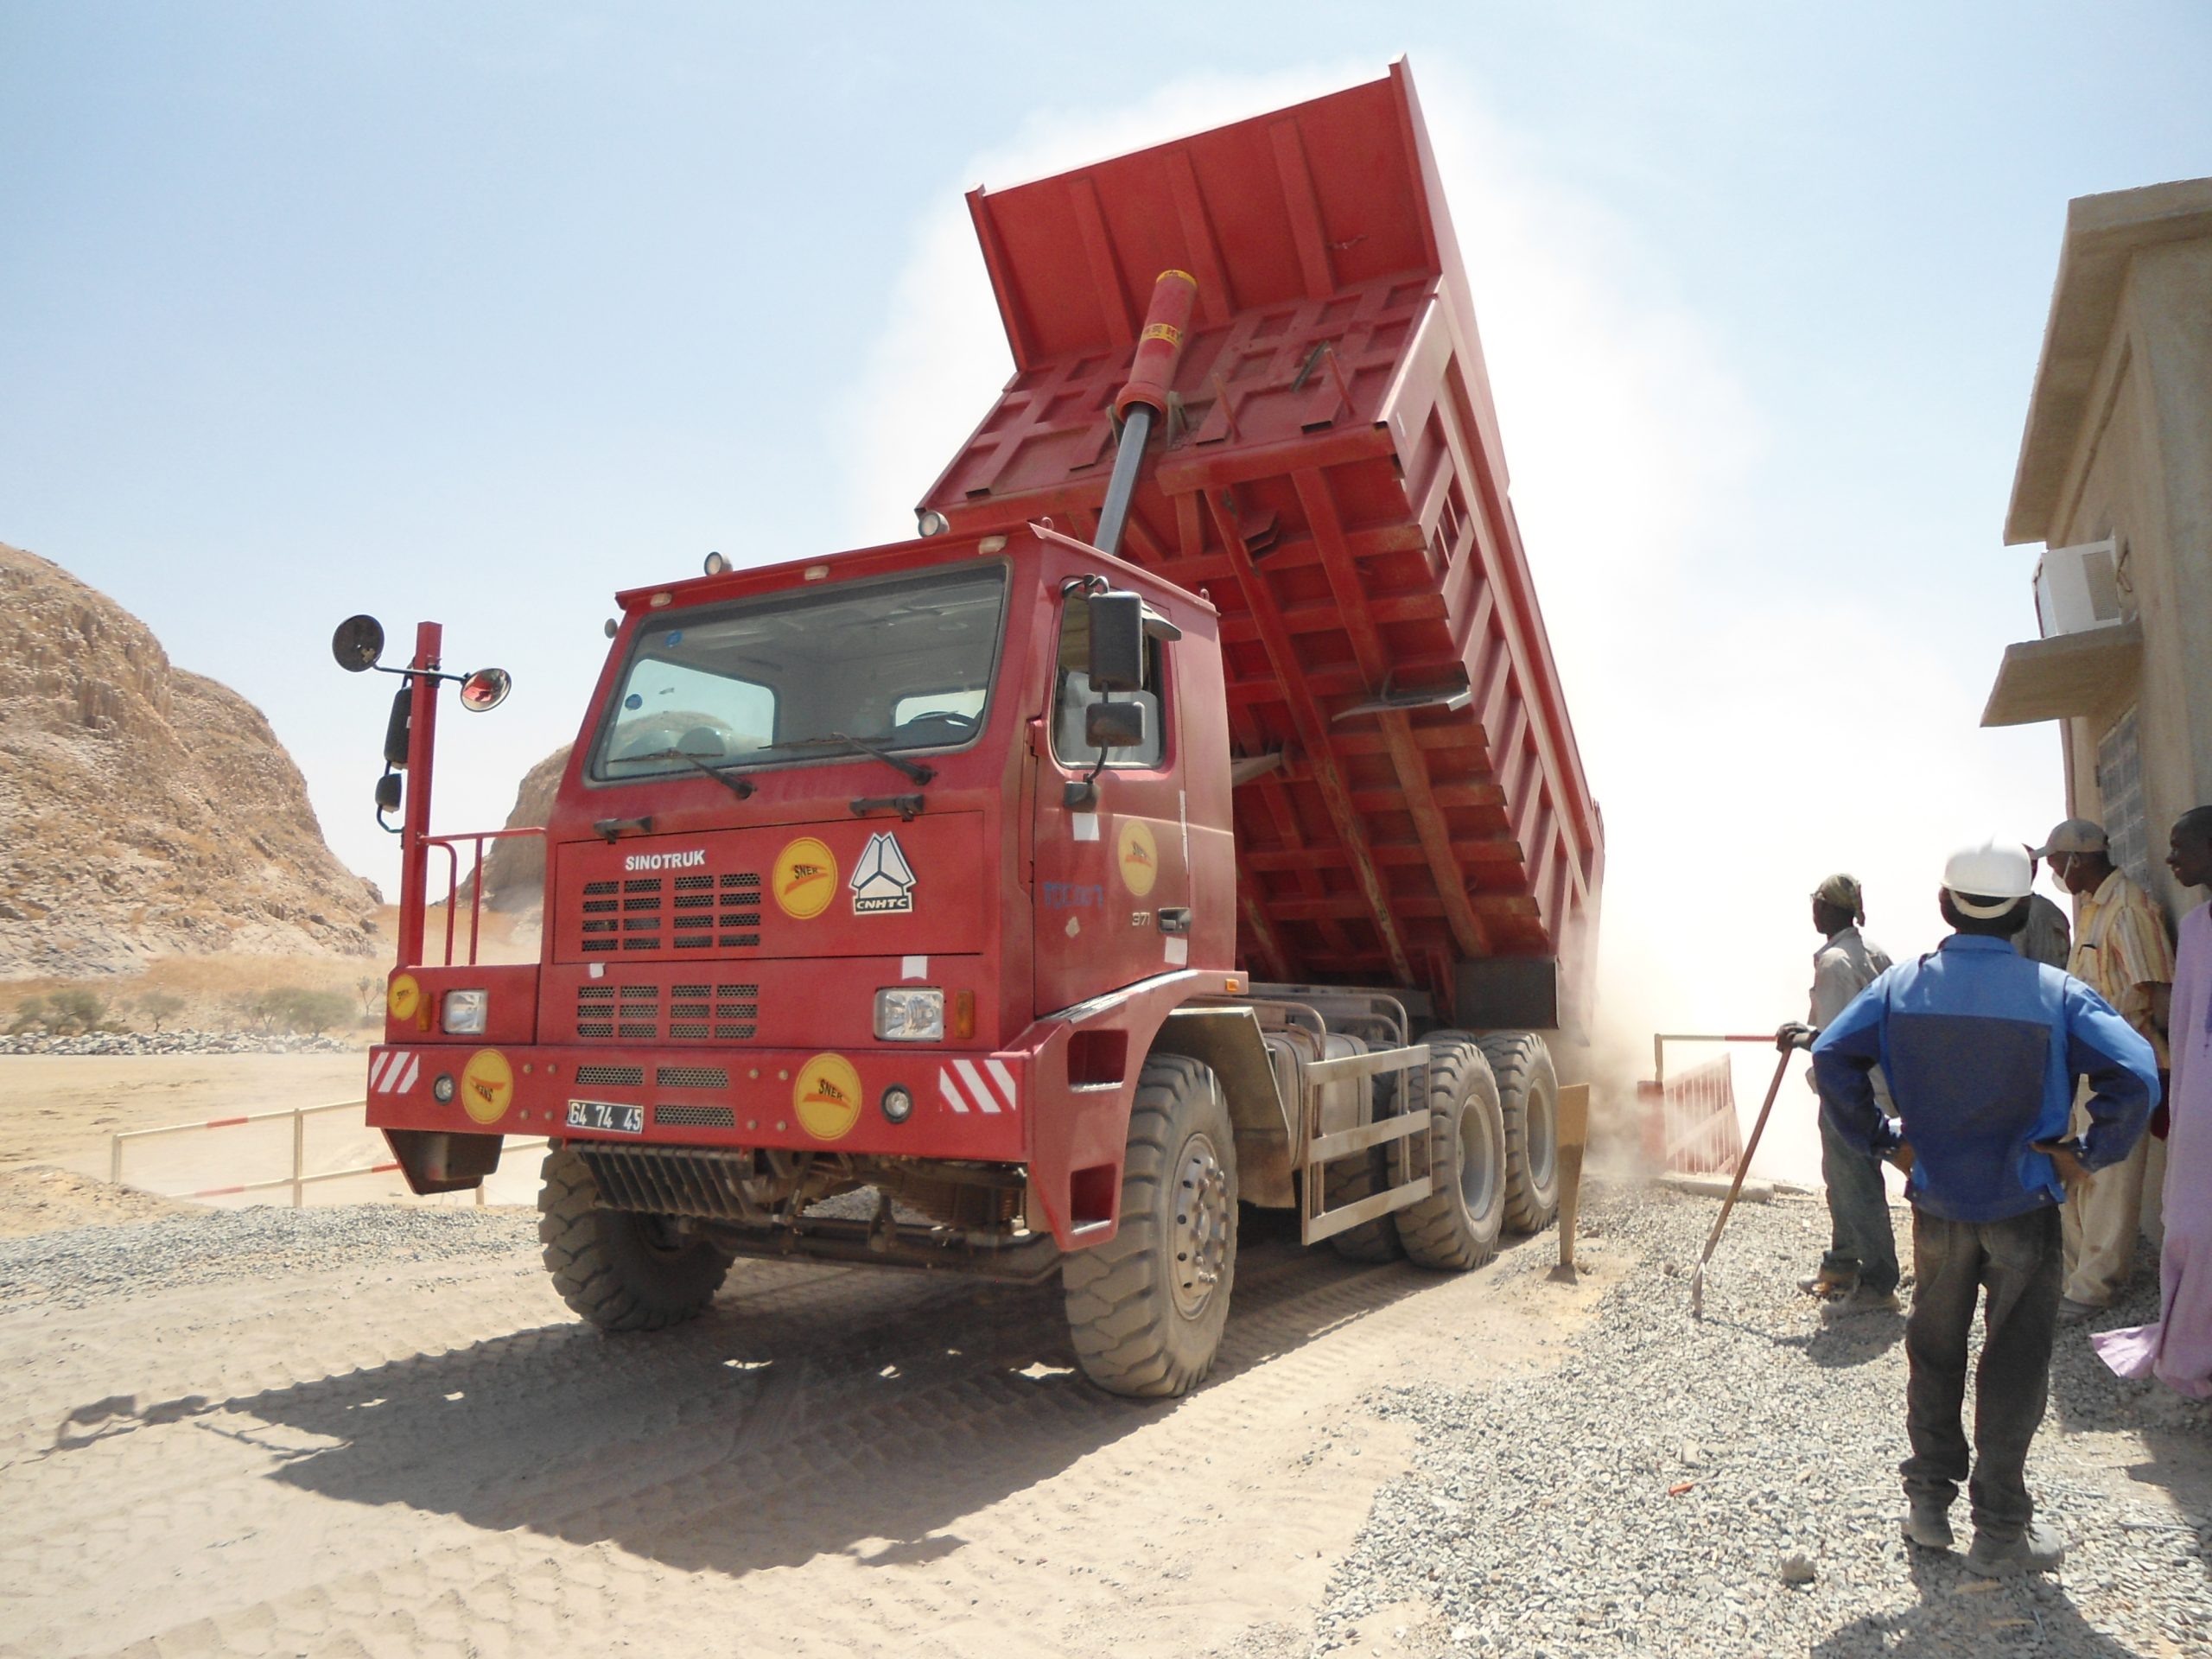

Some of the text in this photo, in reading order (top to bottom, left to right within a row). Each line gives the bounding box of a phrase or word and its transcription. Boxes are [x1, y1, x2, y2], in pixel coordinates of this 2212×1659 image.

[625, 849, 705, 871] SINOTRUK
[856, 898, 907, 909] CNHTC
[1132, 912, 1150, 925] 371
[569, 1103, 641, 1130] 64 74 45
